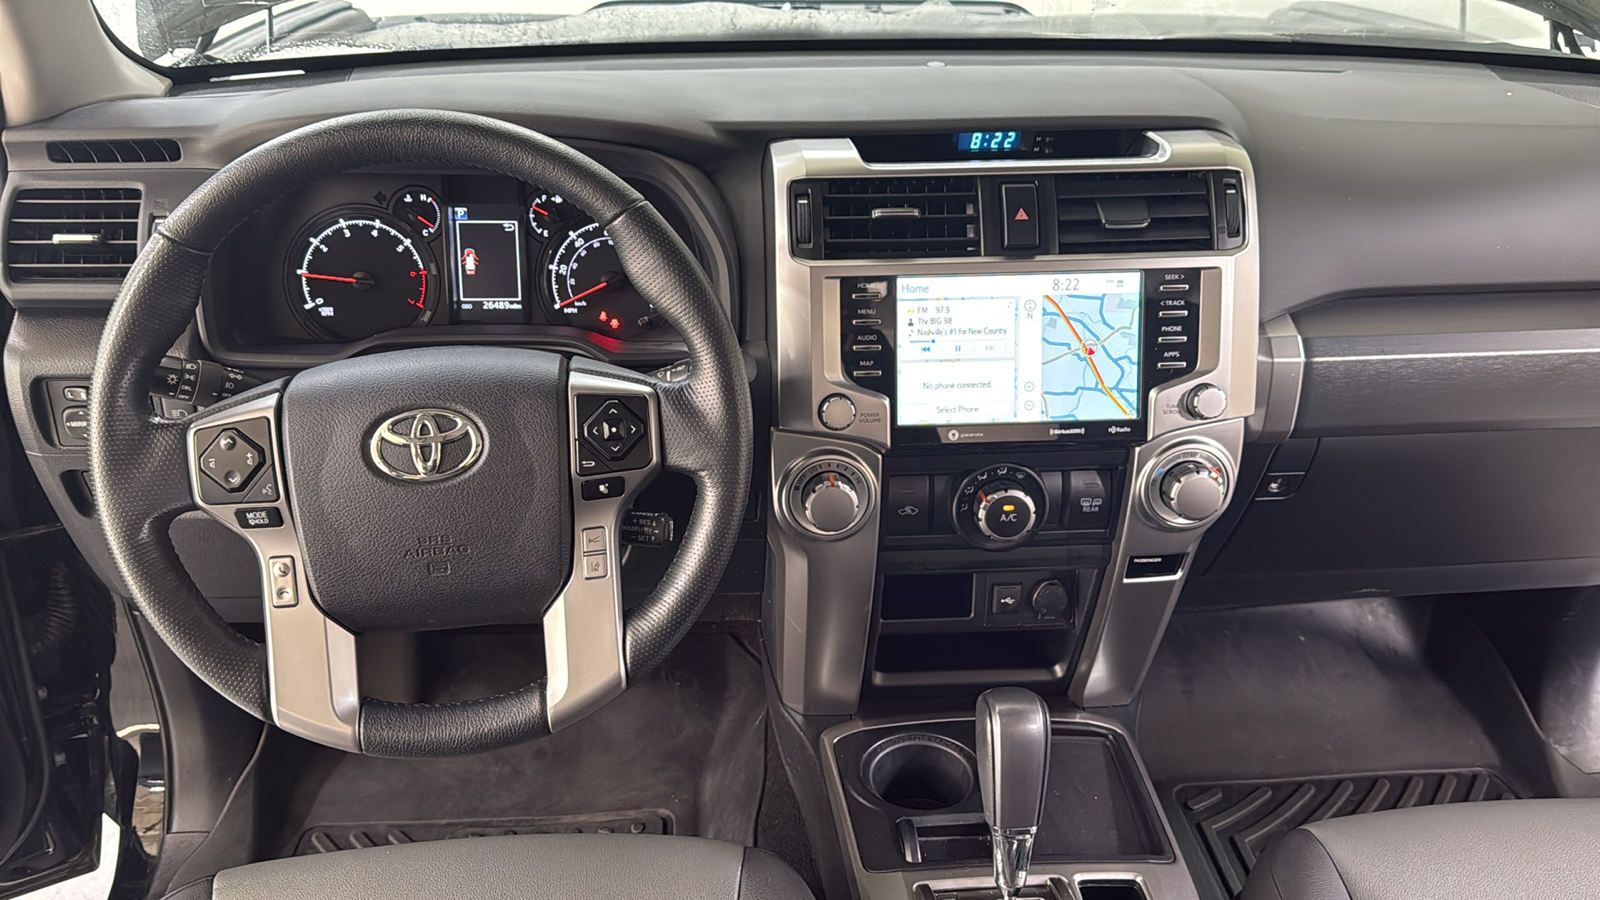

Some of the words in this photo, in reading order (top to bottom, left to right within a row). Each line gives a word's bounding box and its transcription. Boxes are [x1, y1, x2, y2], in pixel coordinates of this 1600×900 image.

[970, 131, 1016, 149] 8:22
[343, 229, 351, 238] 3
[371, 229, 378, 238] 4
[543, 229, 549, 238] E
[574, 238, 585, 248] 40
[319, 244, 329, 253] 2
[396, 244, 405, 253] 5
[559, 264, 567, 275] 20
[901, 283, 930, 293] Home
[1052, 278, 1080, 291] 8:22
[315, 297, 324, 305] 0
[935, 306, 950, 314] 97.9
[918, 317, 928, 325] The
[930, 317, 942, 325] BIG
[943, 317, 952, 325] 98
[983, 327, 1007, 336] Country
[181, 384, 192, 392] DRL
[923, 381, 930, 390] No
[932, 381, 957, 392] phone
[80, 392, 87, 400] R
[936, 405, 956, 414] Select
[958, 405, 979, 413] Phone
[245, 510, 268, 519] MODE
[1000, 513, 1018, 522] A/C
[639, 518, 651, 526] RES
[404, 545, 471, 558] AIRBAG
